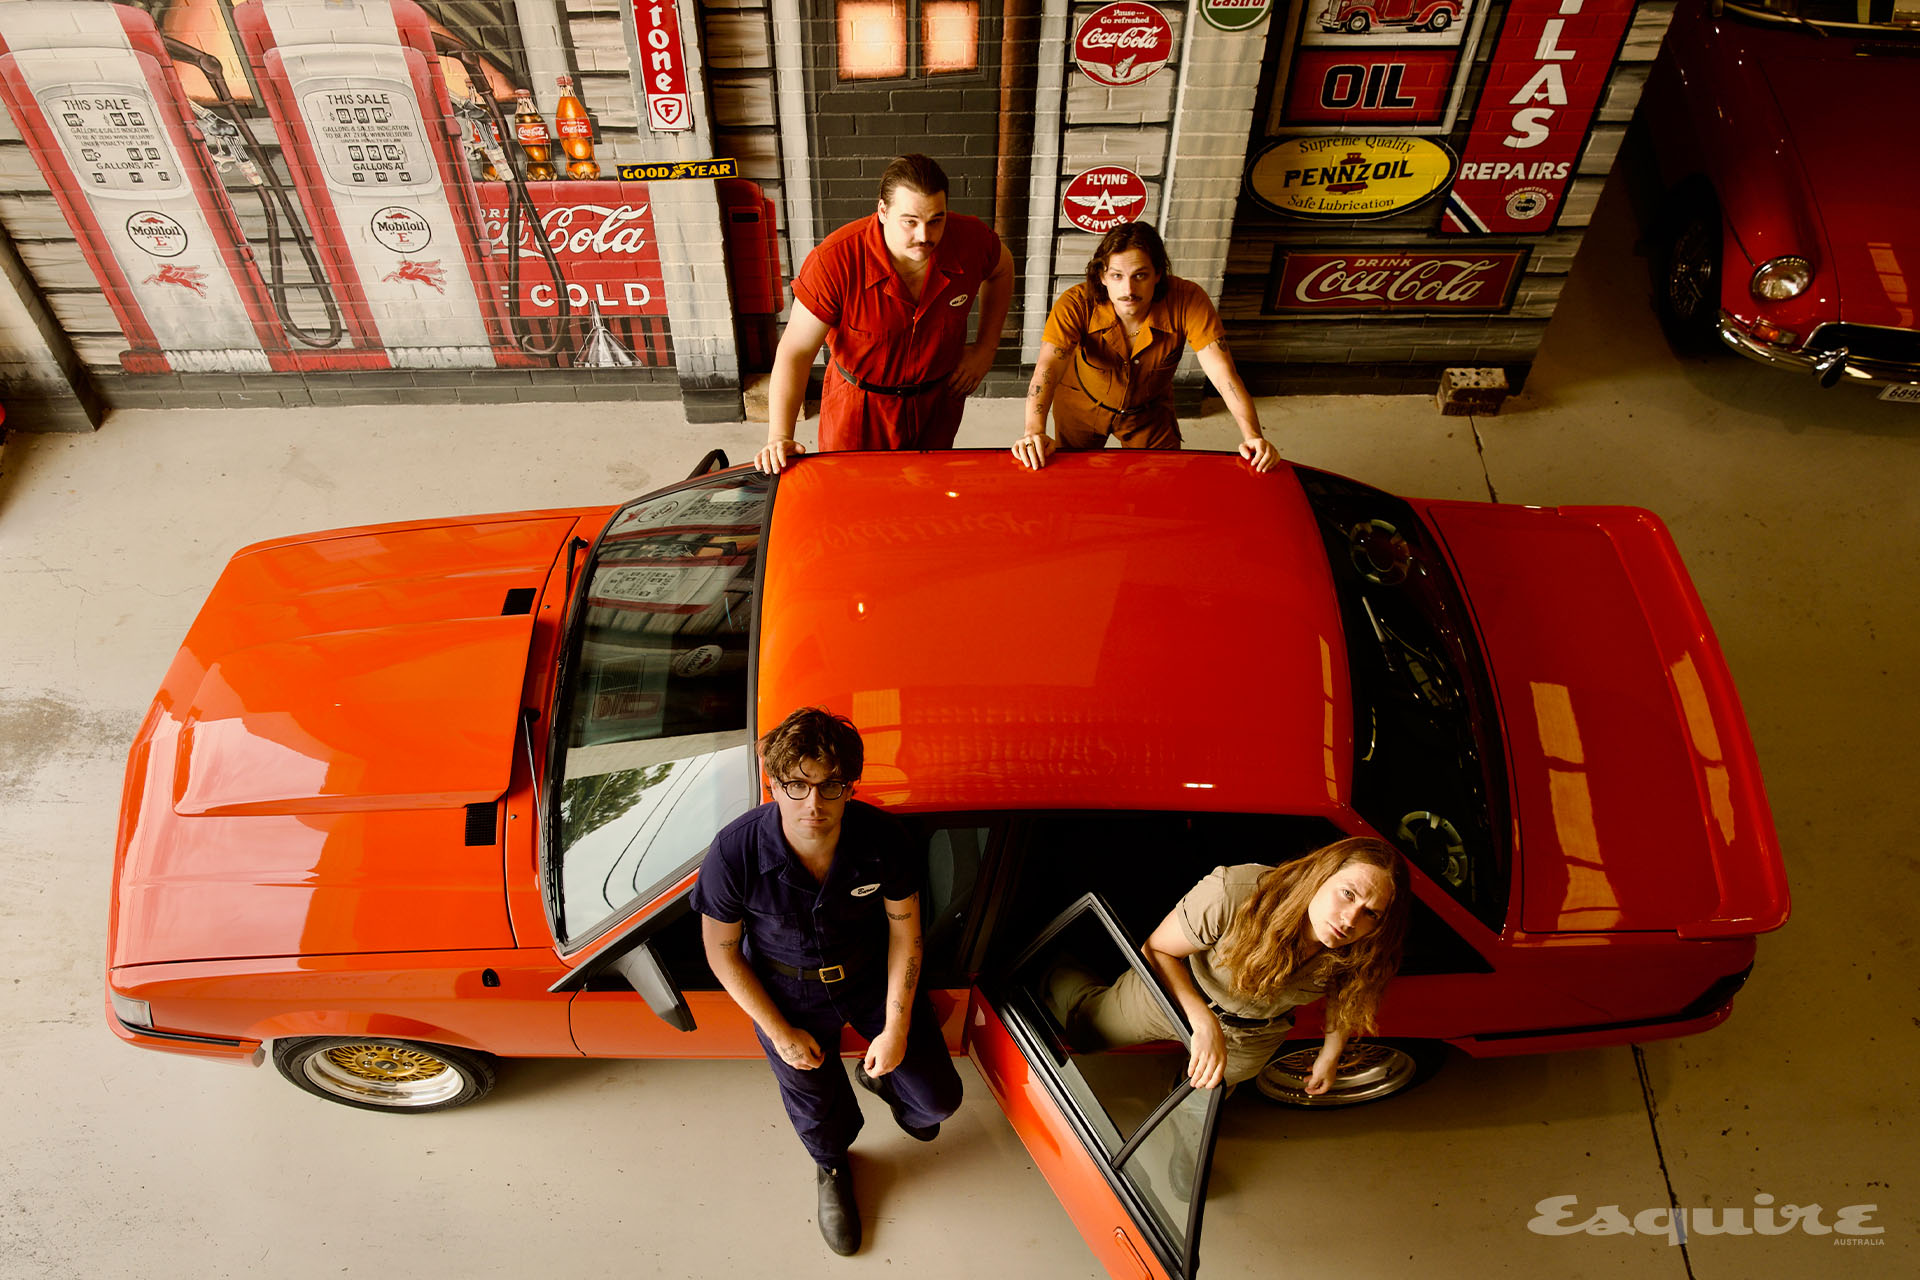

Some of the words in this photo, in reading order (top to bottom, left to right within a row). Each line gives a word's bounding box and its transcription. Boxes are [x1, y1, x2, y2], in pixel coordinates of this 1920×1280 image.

[1100, 16, 1112, 24] Go
[1113, 16, 1150, 24] refreshed
[1082, 26, 1164, 48] Coca-Cola
[648, 0, 673, 92] tone
[1320, 63, 1416, 109] OIL
[63, 99, 91, 111] THIS
[95, 98, 132, 110] SALE
[326, 94, 354, 105] THIS
[356, 93, 390, 104] SALE
[1299, 135, 1361, 154] Supreme
[1365, 135, 1416, 154] Quality
[96, 161, 142, 170] GALLONS
[353, 162, 394, 171] GALLONS
[394, 162, 406, 170] AT
[1282, 160, 1414, 188] PENNZOIL
[1459, 162, 1571, 180] REPAIRS
[1086, 173, 1128, 185] FLYING
[1091, 188, 1116, 215] A
[1288, 193, 1316, 210] Safe
[1318, 197, 1395, 211] Lubrication
[376, 221, 426, 232] Mobiloil
[1077, 214, 1129, 230] SERVICE
[130, 226, 182, 236] Mobiloil
[1353, 258, 1414, 267] DRINK
[1295, 259, 1500, 303] Coca-Cola
[530, 283, 651, 308] COLD
